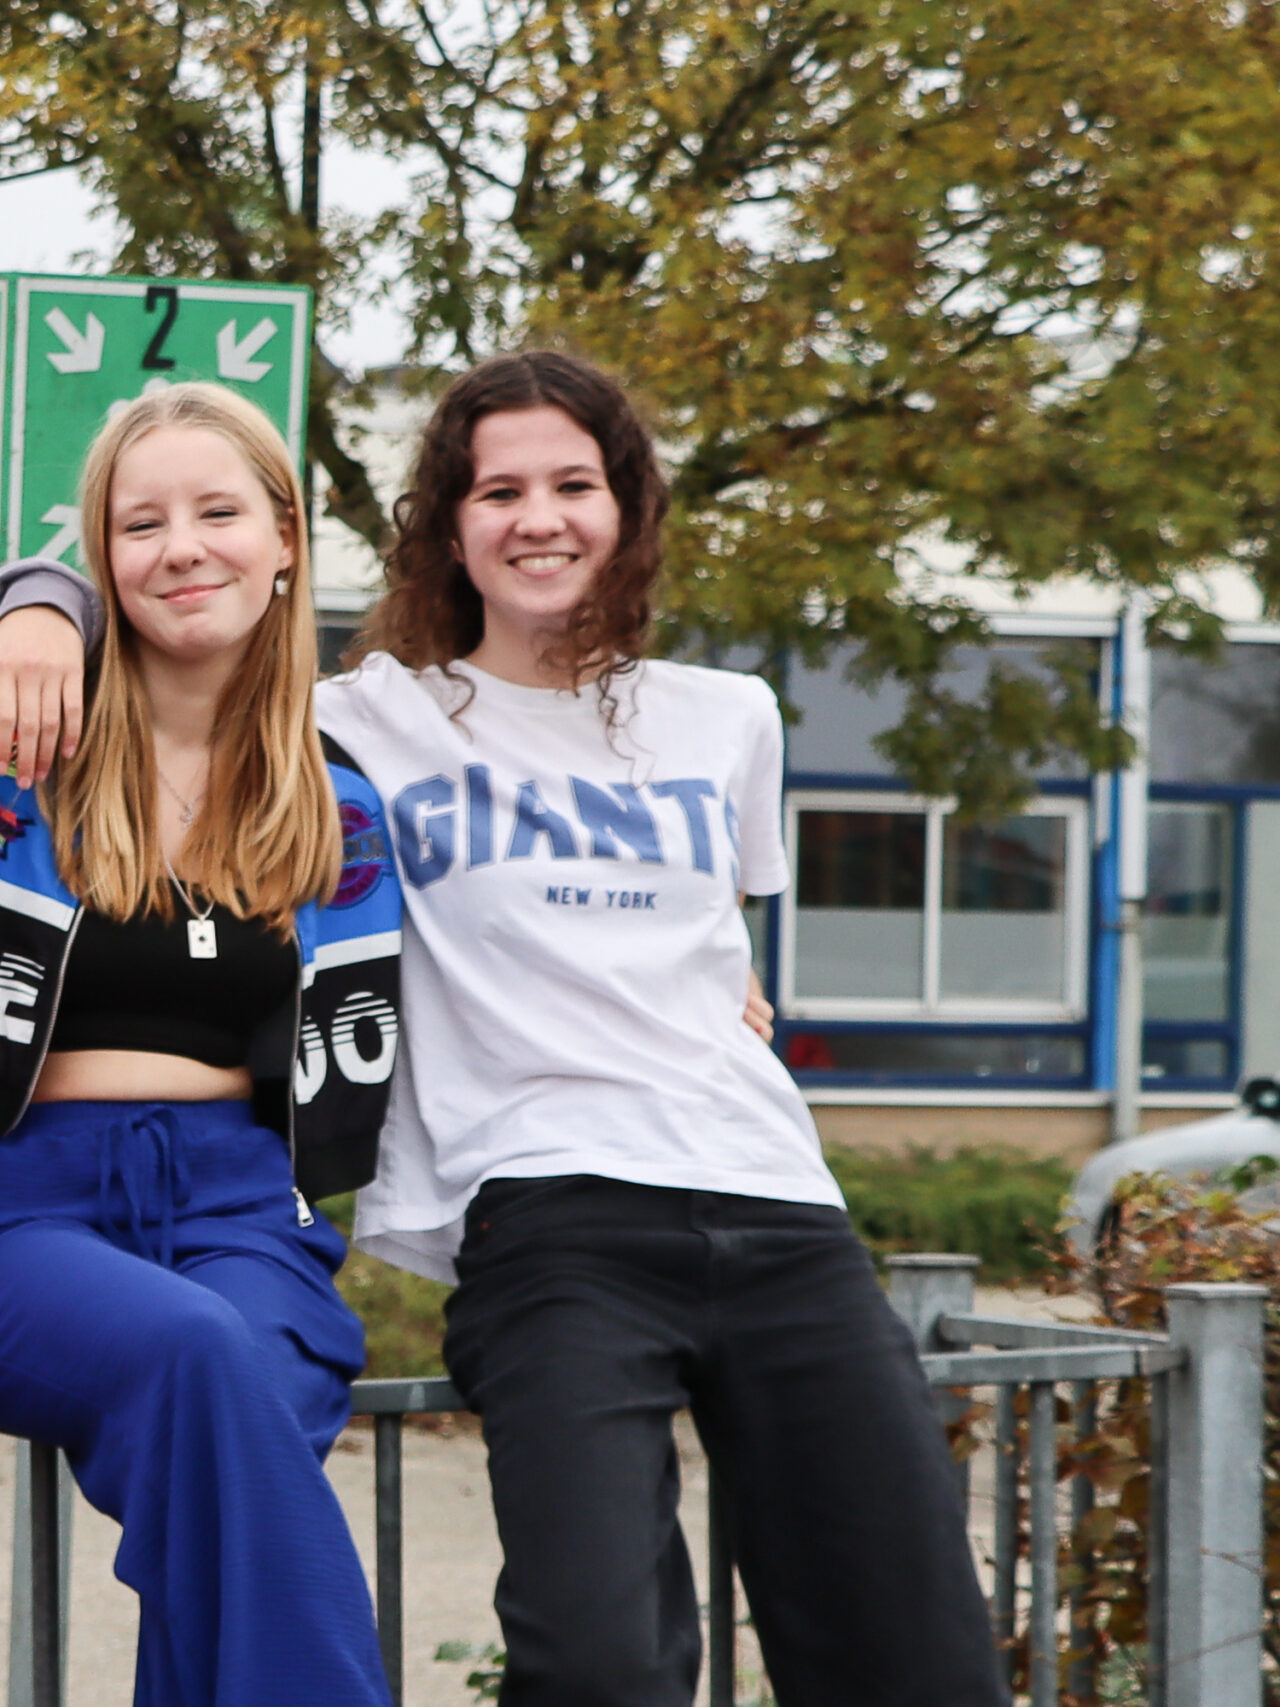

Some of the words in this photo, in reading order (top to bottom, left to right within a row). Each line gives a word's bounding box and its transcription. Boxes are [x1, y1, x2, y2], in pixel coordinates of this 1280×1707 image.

[140, 286, 179, 369] 2
[393, 762, 740, 890] GIANT
[547, 885, 591, 905] NEW
[605, 889, 658, 911] YORK
